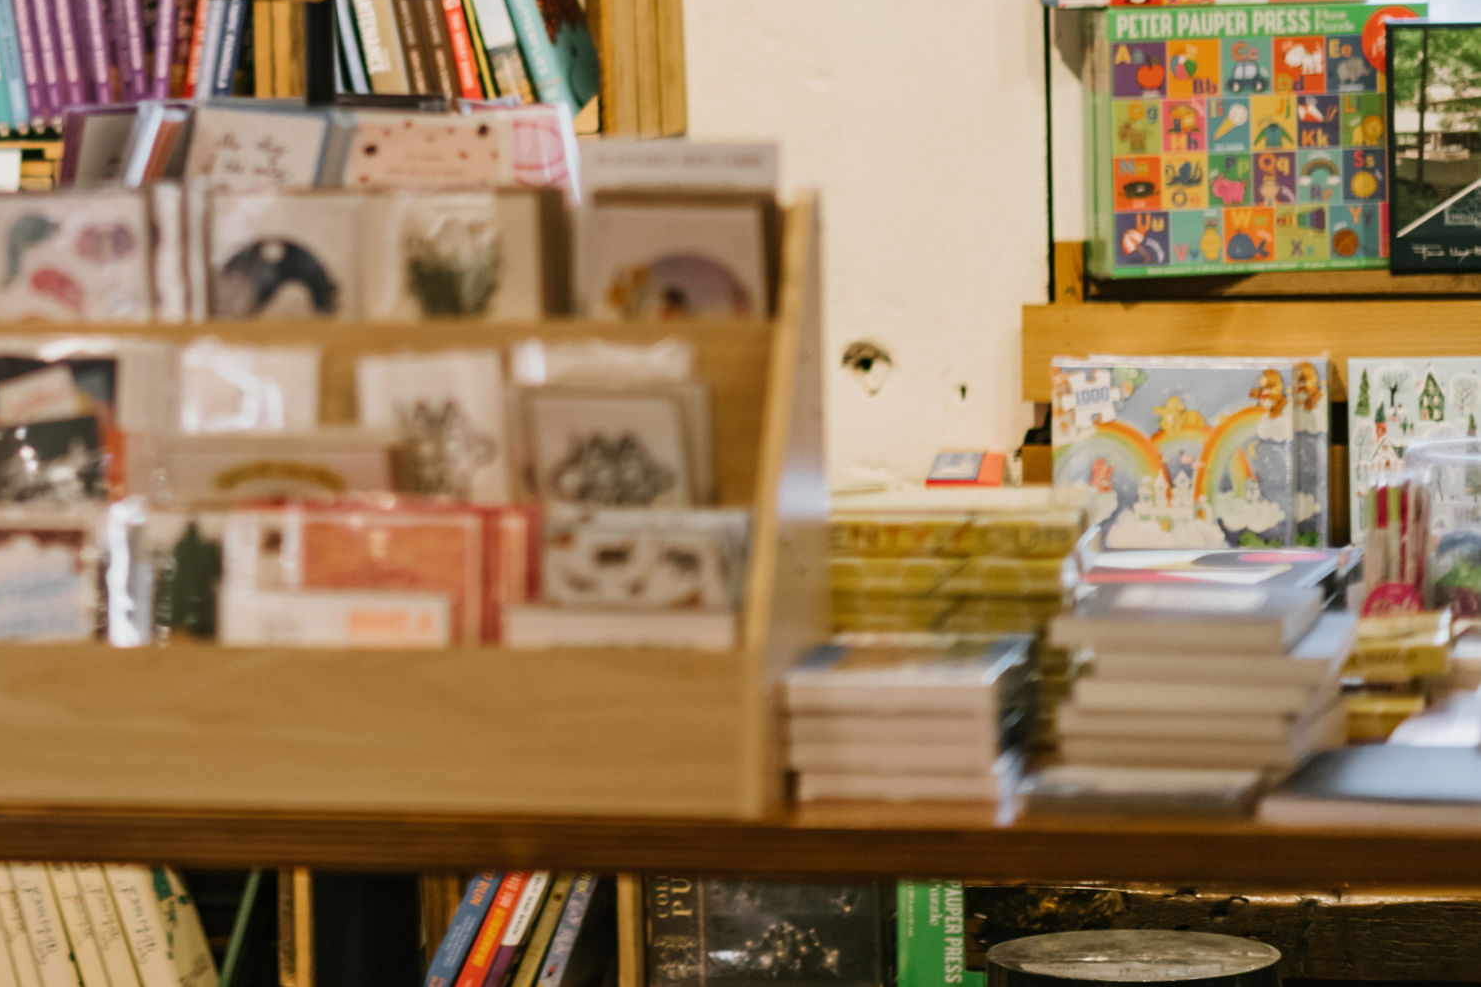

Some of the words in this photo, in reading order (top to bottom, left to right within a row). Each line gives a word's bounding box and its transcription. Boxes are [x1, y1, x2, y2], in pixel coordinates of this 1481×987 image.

[1117, 13, 1174, 38] PETER
[1177, 11, 1248, 37] PAUPER
[1252, 8, 1310, 34] PRESS
[1074, 385, 1111, 405] 1000
[469, 879, 489, 907] RUN
[944, 937, 962, 983] PRESS
